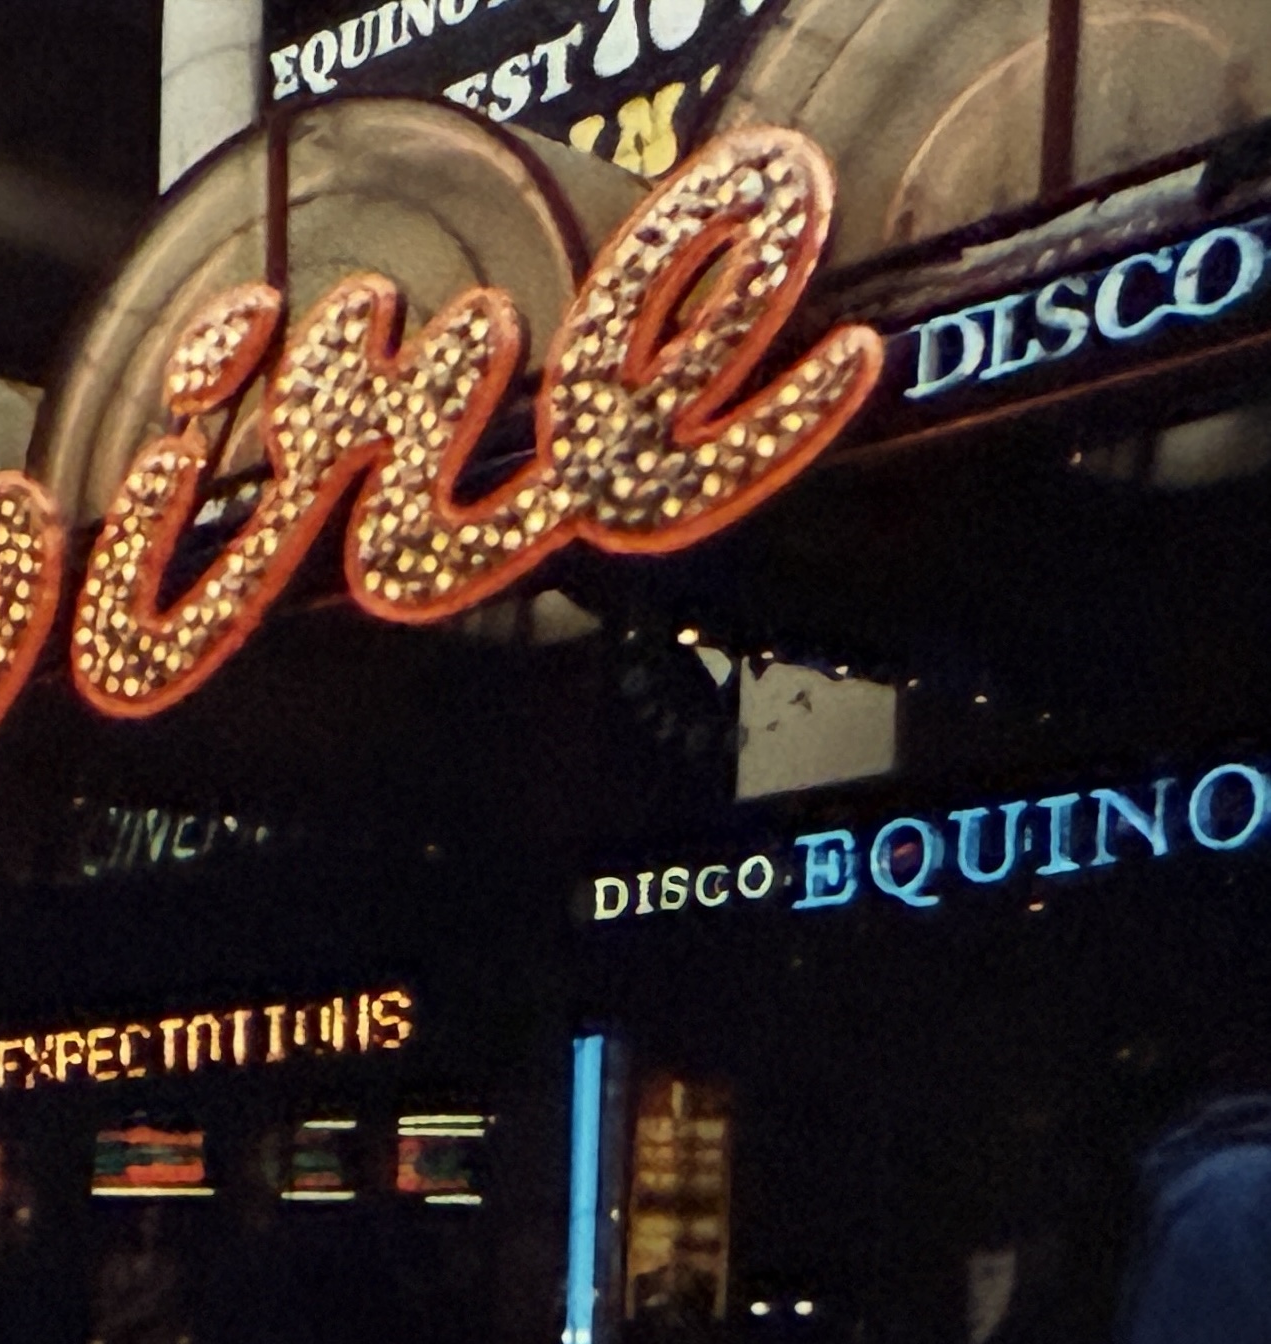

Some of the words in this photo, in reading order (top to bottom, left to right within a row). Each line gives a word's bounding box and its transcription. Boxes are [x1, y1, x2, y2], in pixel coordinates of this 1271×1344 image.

[902, 226, 1265, 399] DISCO
[594, 854, 775, 921] DISCO
[791, 763, 1271, 911] EQUINO
